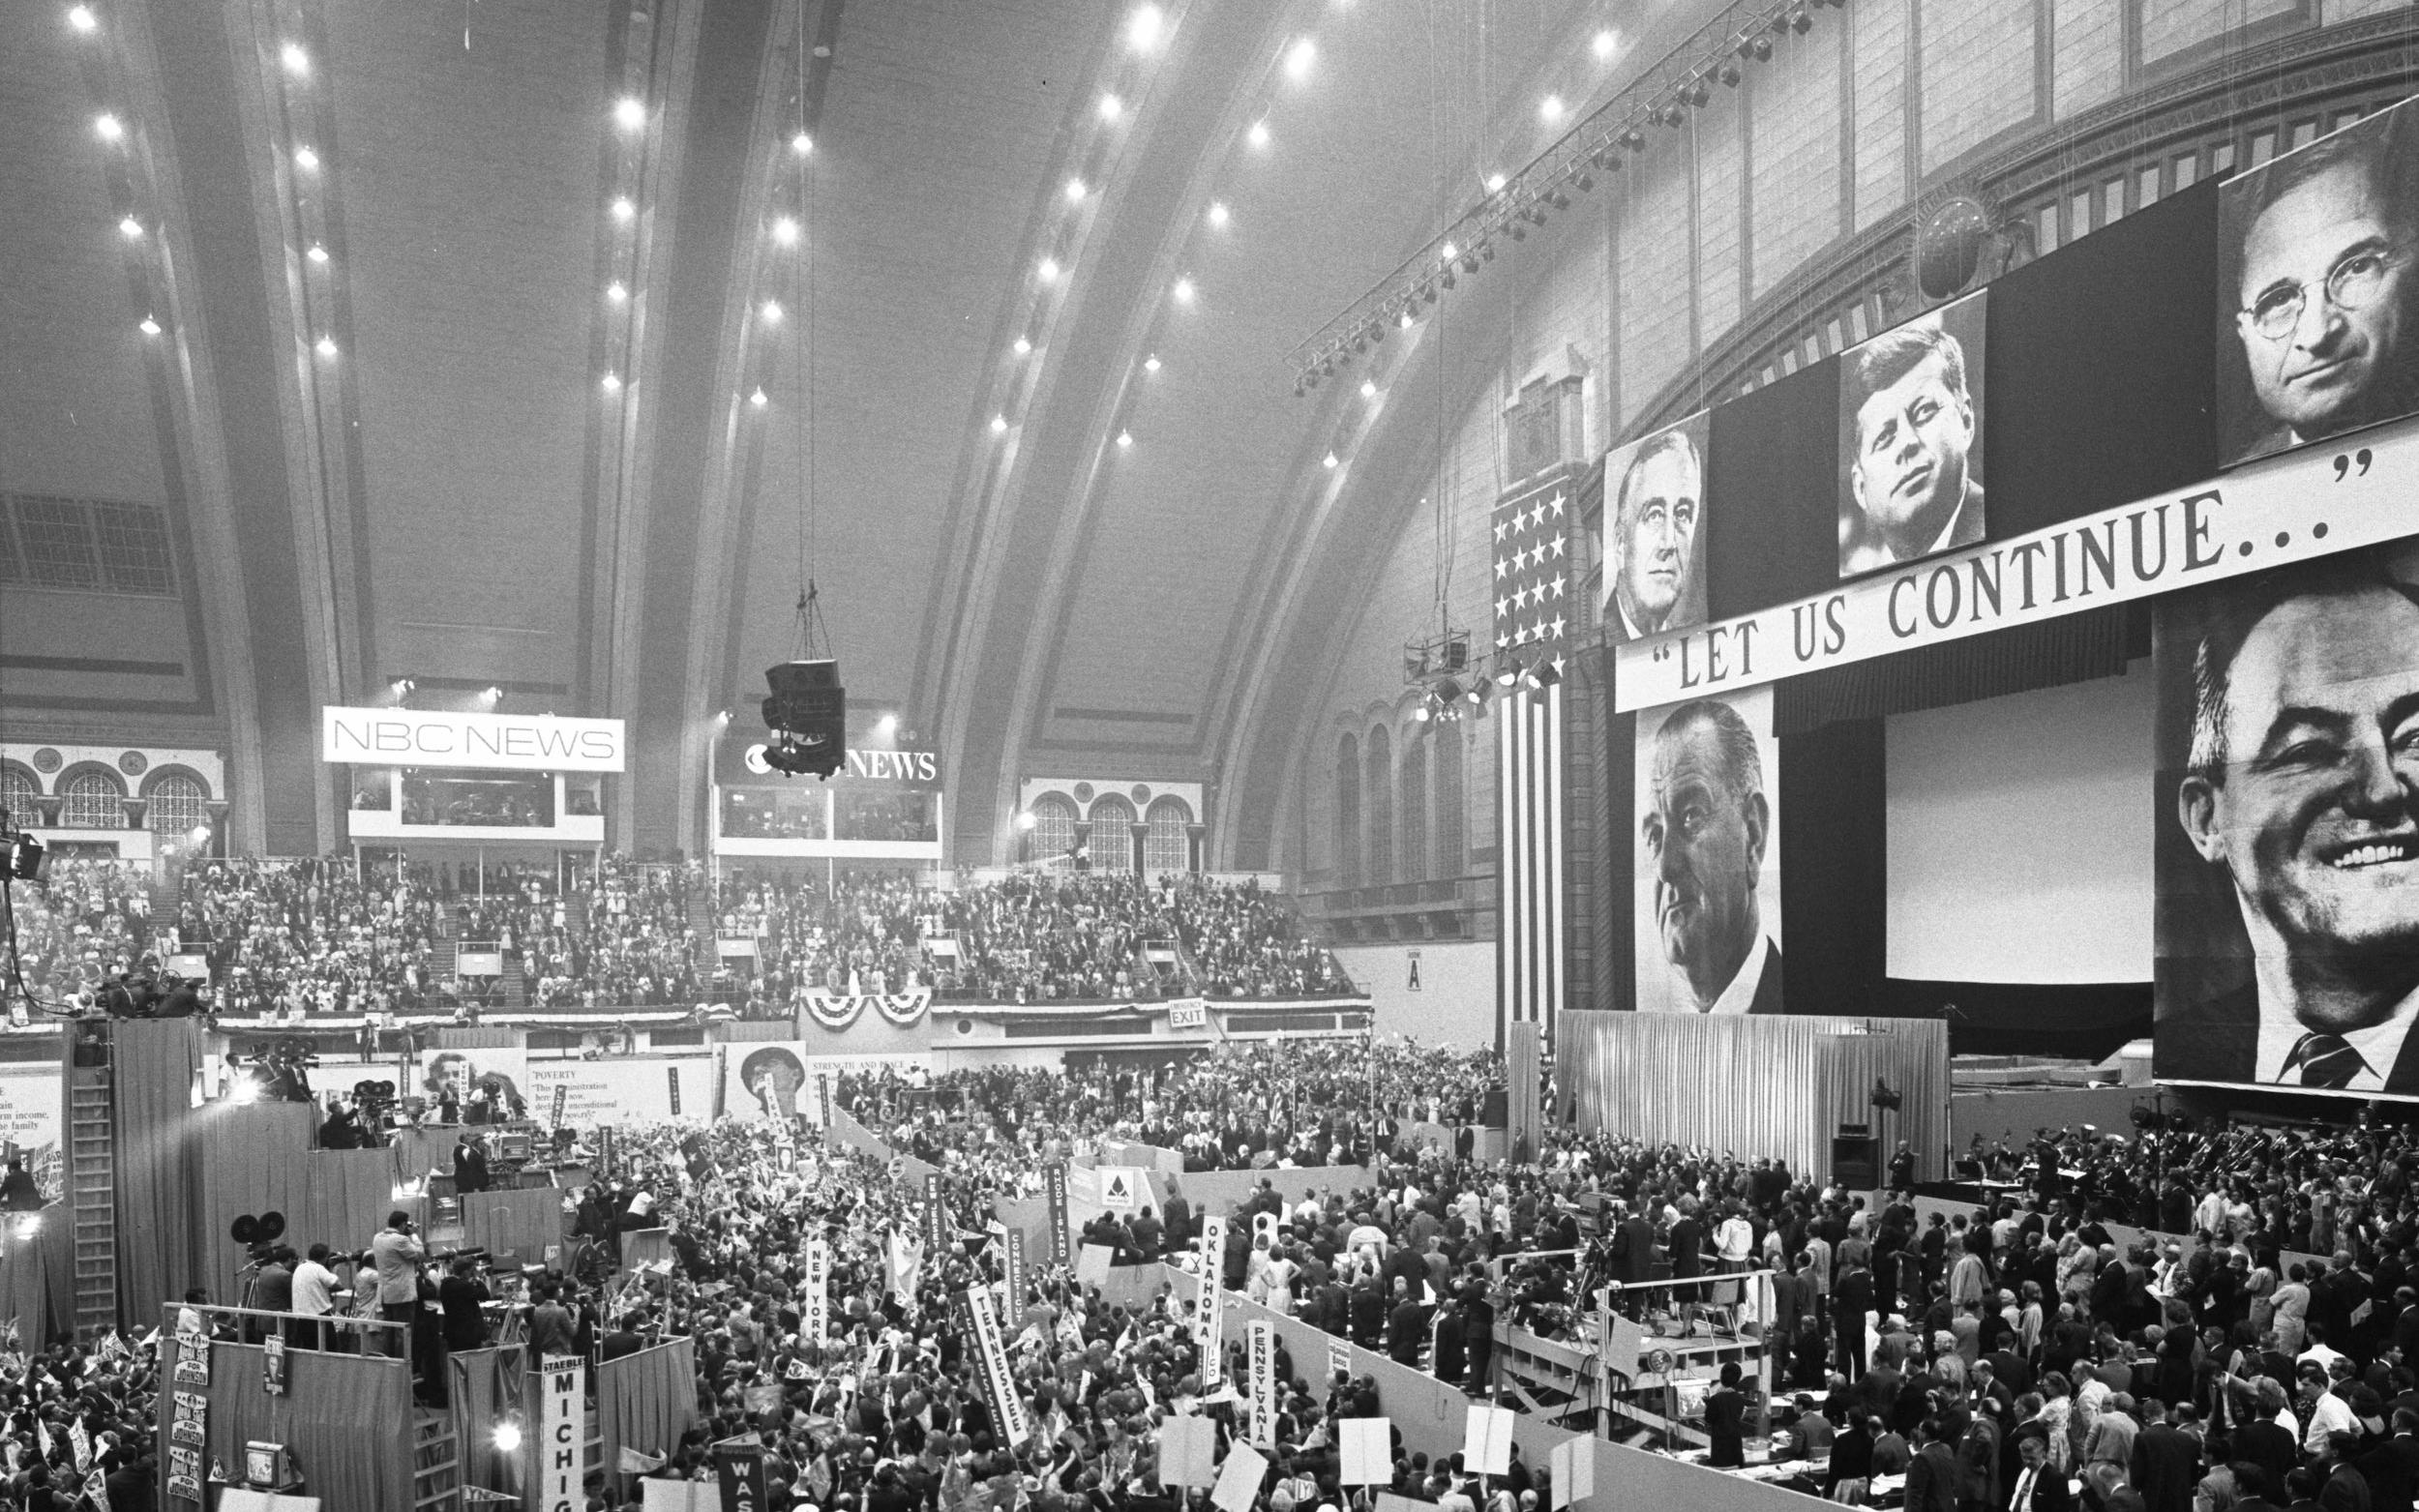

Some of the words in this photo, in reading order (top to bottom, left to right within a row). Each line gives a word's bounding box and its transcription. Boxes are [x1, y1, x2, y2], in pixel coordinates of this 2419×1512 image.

[1791, 594, 1846, 663] US
[334, 720, 453, 753] NBC
[466, 726, 614, 759] NEWS
[846, 749, 937, 782] NEWS
[1409, 960, 1419, 988] A
[1172, 1010, 1202, 1023] EXIT
[813, 1061, 854, 1070] STRENGTH
[860, 1060, 877, 1069] AND
[12, 1120, 39, 1132] family
[552, 1087, 564, 1128] FLORIDA
[1053, 1168, 1062, 1206] RHODE
[931, 1202, 940, 1249] JERSEY
[1057, 1211, 1066, 1258] ISLAND
[811, 1250, 821, 1284] NEW
[1012, 1234, 1022, 1322] CONNECTICUT
[1199, 1225, 1219, 1339] OKLAHOMA
[811, 1294, 821, 1341] YORK
[176, 1369, 207, 1384] JOHNSON
[187, 1362, 200, 1371] FOR
[544, 1357, 585, 1372] STAEBLE
[961, 1302, 1004, 1438] TENNESSEE
[976, 1296, 1022, 1433] TENNESSEE
[1253, 1326, 1267, 1443] PENNSYLVANIA
[173, 1428, 203, 1445] JOHNSON
[184, 1421, 197, 1431] FOR
[554, 1373, 574, 1512] MICHIG
[180, 1477, 194, 1487] FOR
[732, 1462, 753, 1512] WAS
